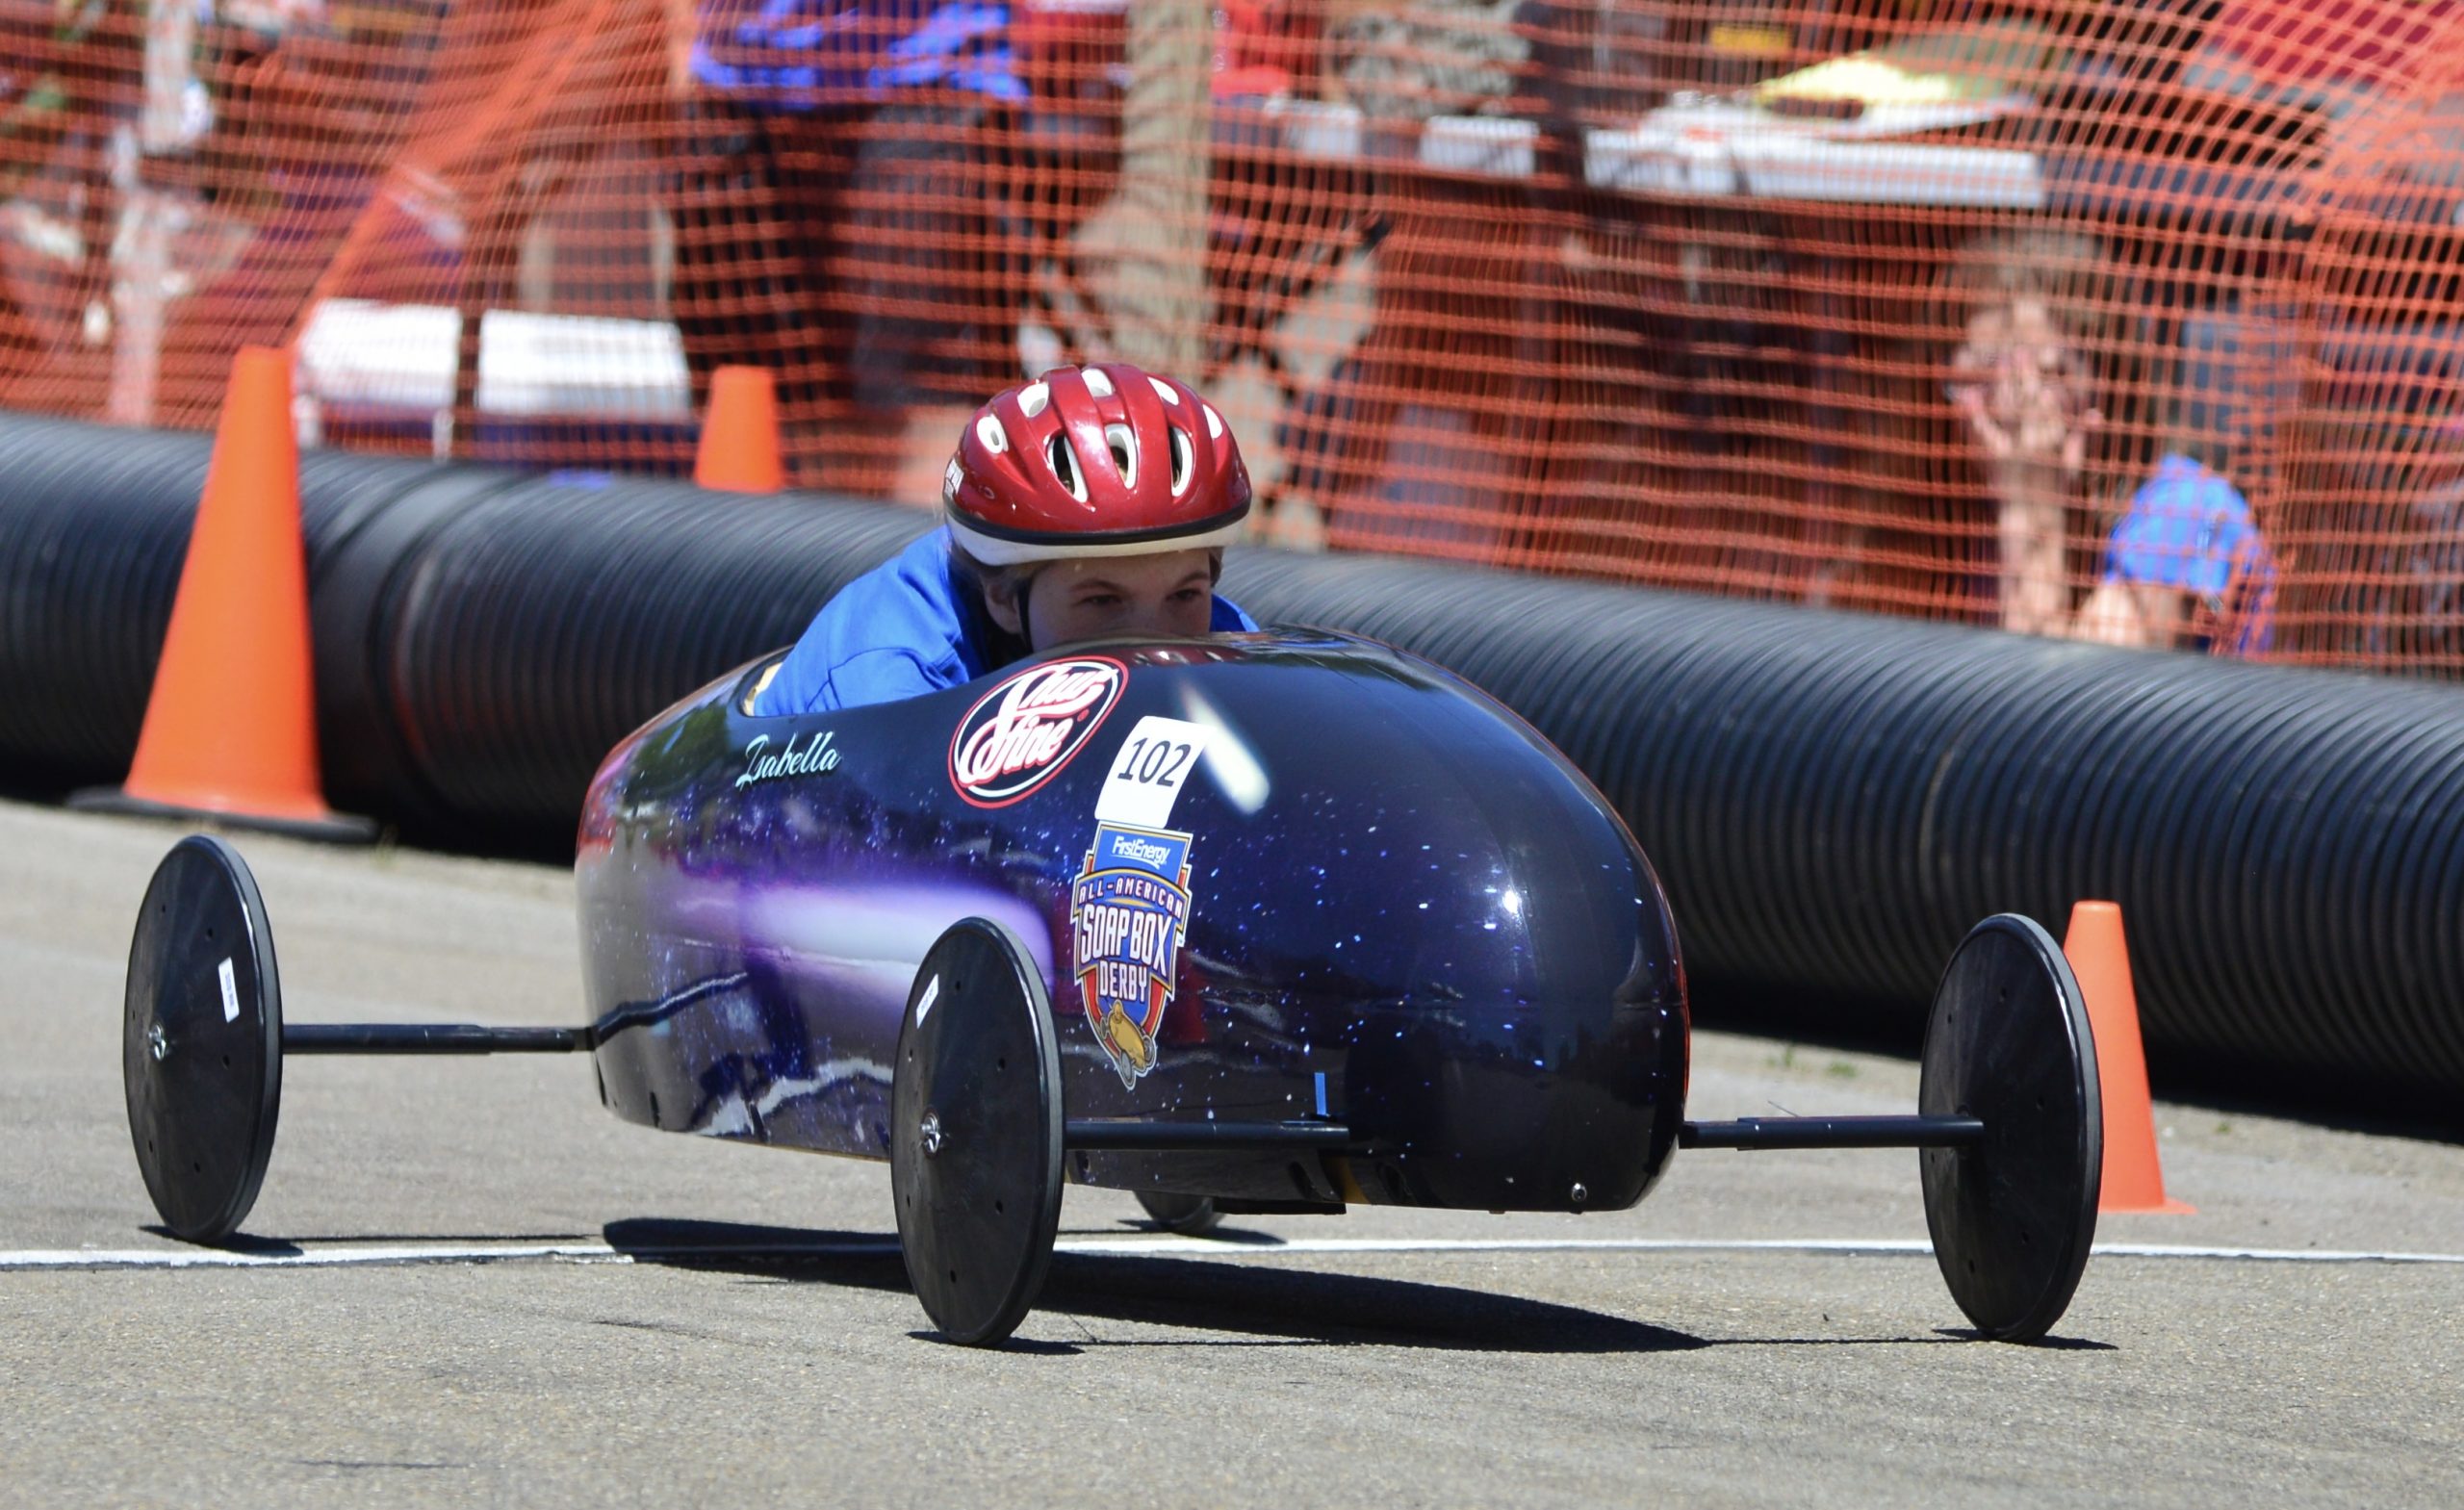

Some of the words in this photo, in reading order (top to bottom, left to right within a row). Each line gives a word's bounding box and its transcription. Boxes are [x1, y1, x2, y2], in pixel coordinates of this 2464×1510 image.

[734, 731, 842, 791] Isabella
[1117, 737, 1192, 787] 102
[1112, 835, 1170, 865] FirstEnergy
[1078, 878, 1185, 919] ALL-AMERICAN
[1081, 904, 1131, 964] SOAP
[1129, 910, 1173, 978] BOX
[1099, 960, 1147, 1004] DERBY
